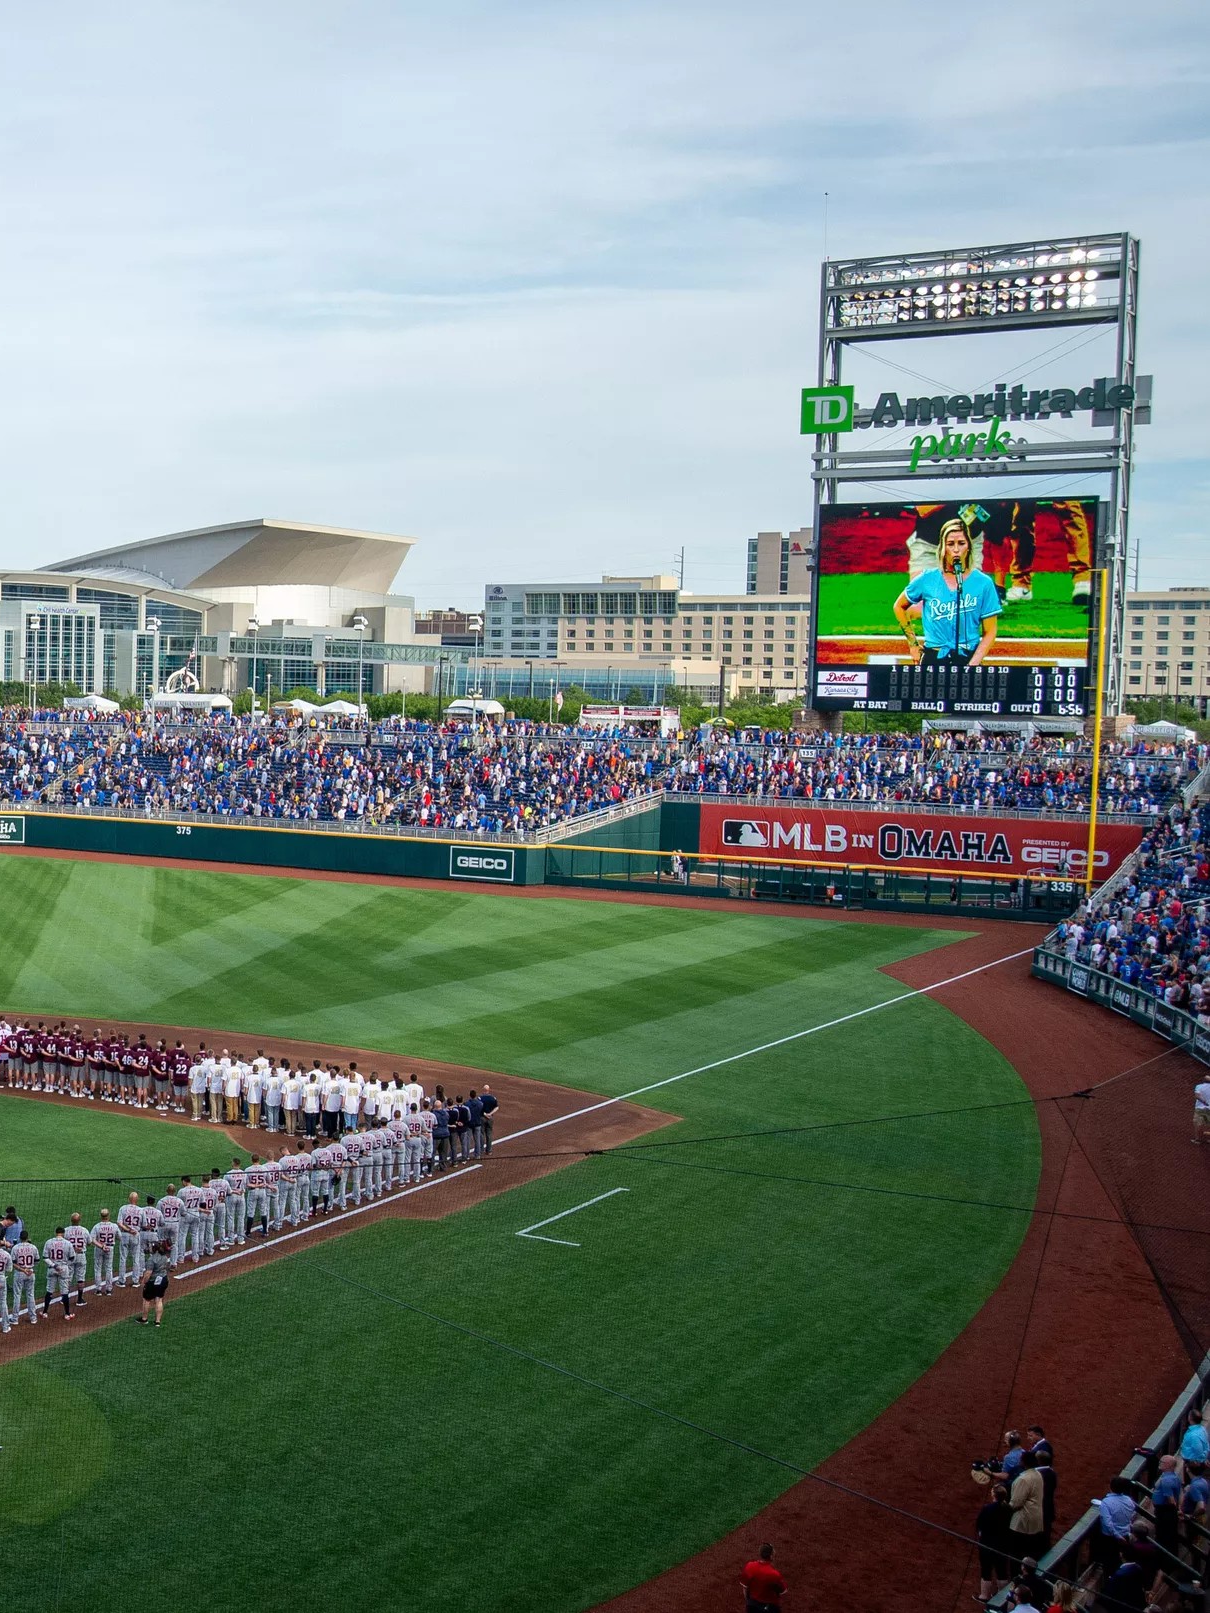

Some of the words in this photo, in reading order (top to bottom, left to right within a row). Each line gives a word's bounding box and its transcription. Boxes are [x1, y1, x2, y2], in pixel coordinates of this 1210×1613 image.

[806, 395, 848, 425] TD
[871, 377, 1135, 421] Ameritrade
[909, 416, 1012, 472] park
[1032, 666, 1039, 674] R
[1052, 666, 1059, 674] H
[1068, 666, 1076, 674] E
[1034, 674, 1042, 687] 0
[1054, 674, 1063, 687] 0
[1067, 674, 1076, 687] 0
[1034, 688, 1042, 701] 0
[1054, 688, 1062, 702] 0
[1066, 689, 1075, 702] 0
[853, 701, 866, 709] AT
[868, 701, 888, 709] BAT
[911, 702, 936, 710] BALL
[936, 701, 944, 712] 0
[954, 703, 992, 711] STRIKE
[992, 702, 1000, 713] 0
[1011, 704, 1032, 712] OUT
[1032, 703, 1040, 714] 0
[1058, 704, 1083, 715] 6:56
[176, 826, 192, 835] 375
[772, 821, 848, 853] MLB
[851, 834, 874, 848] IN
[878, 823, 1013, 865] OMAHA
[1022, 838, 1060, 847] PRESENTED
[1020, 846, 1109, 867] GEICO
[456, 856, 507, 870] GEICO
[1050, 882, 1073, 892] 335
[10, 1041, 18, 1050] 13
[24, 1044, 33, 1053] 34
[47, 1044, 56, 1053] 44
[75, 1050, 84, 1059] 15
[94, 1051, 104, 1060] 55
[138, 1056, 149, 1066] 24
[160, 1061, 166, 1071] 3
[176, 1064, 187, 1074] 22
[410, 1123, 420, 1132] 38
[347, 1144, 360, 1153] 22
[332, 1153, 343, 1162] 19
[236, 1180, 242, 1189] 7
[251, 1175, 264, 1184] 55
[186, 1198, 199, 1208] 77
[164, 1208, 178, 1218] 97
[124, 1216, 140, 1227] 43
[99, 1233, 114, 1243] 52
[50, 1249, 63, 1260] 18
[18, 1255, 33, 1266] 30
